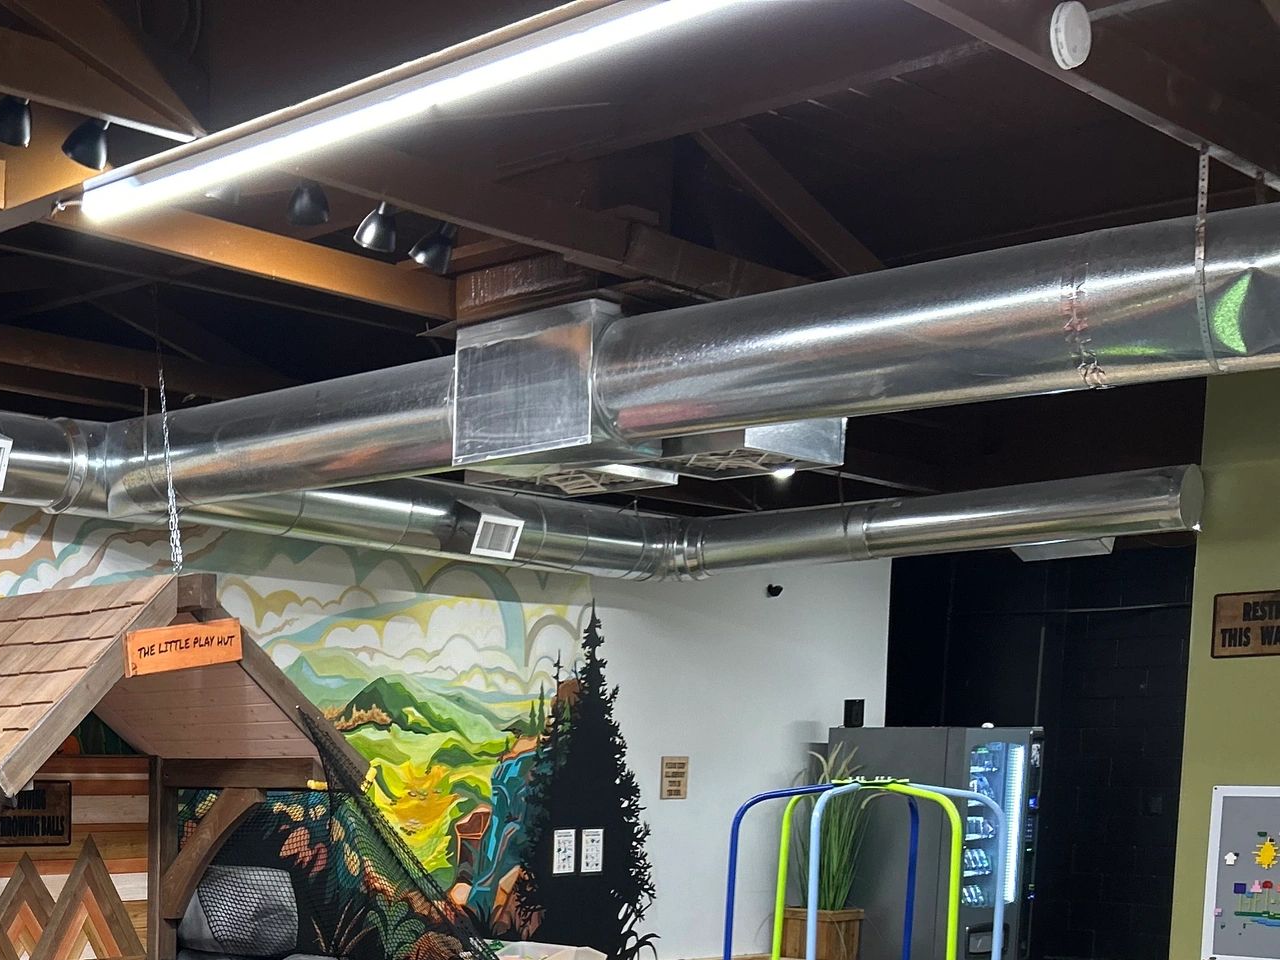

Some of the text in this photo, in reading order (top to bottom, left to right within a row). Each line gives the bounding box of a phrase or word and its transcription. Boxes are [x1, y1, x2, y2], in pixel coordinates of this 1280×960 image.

[137, 635, 235, 659] THE LITTLE PLAY HUT
[1220, 627, 1251, 648] THIS
[41, 815, 65, 836] BALLS
